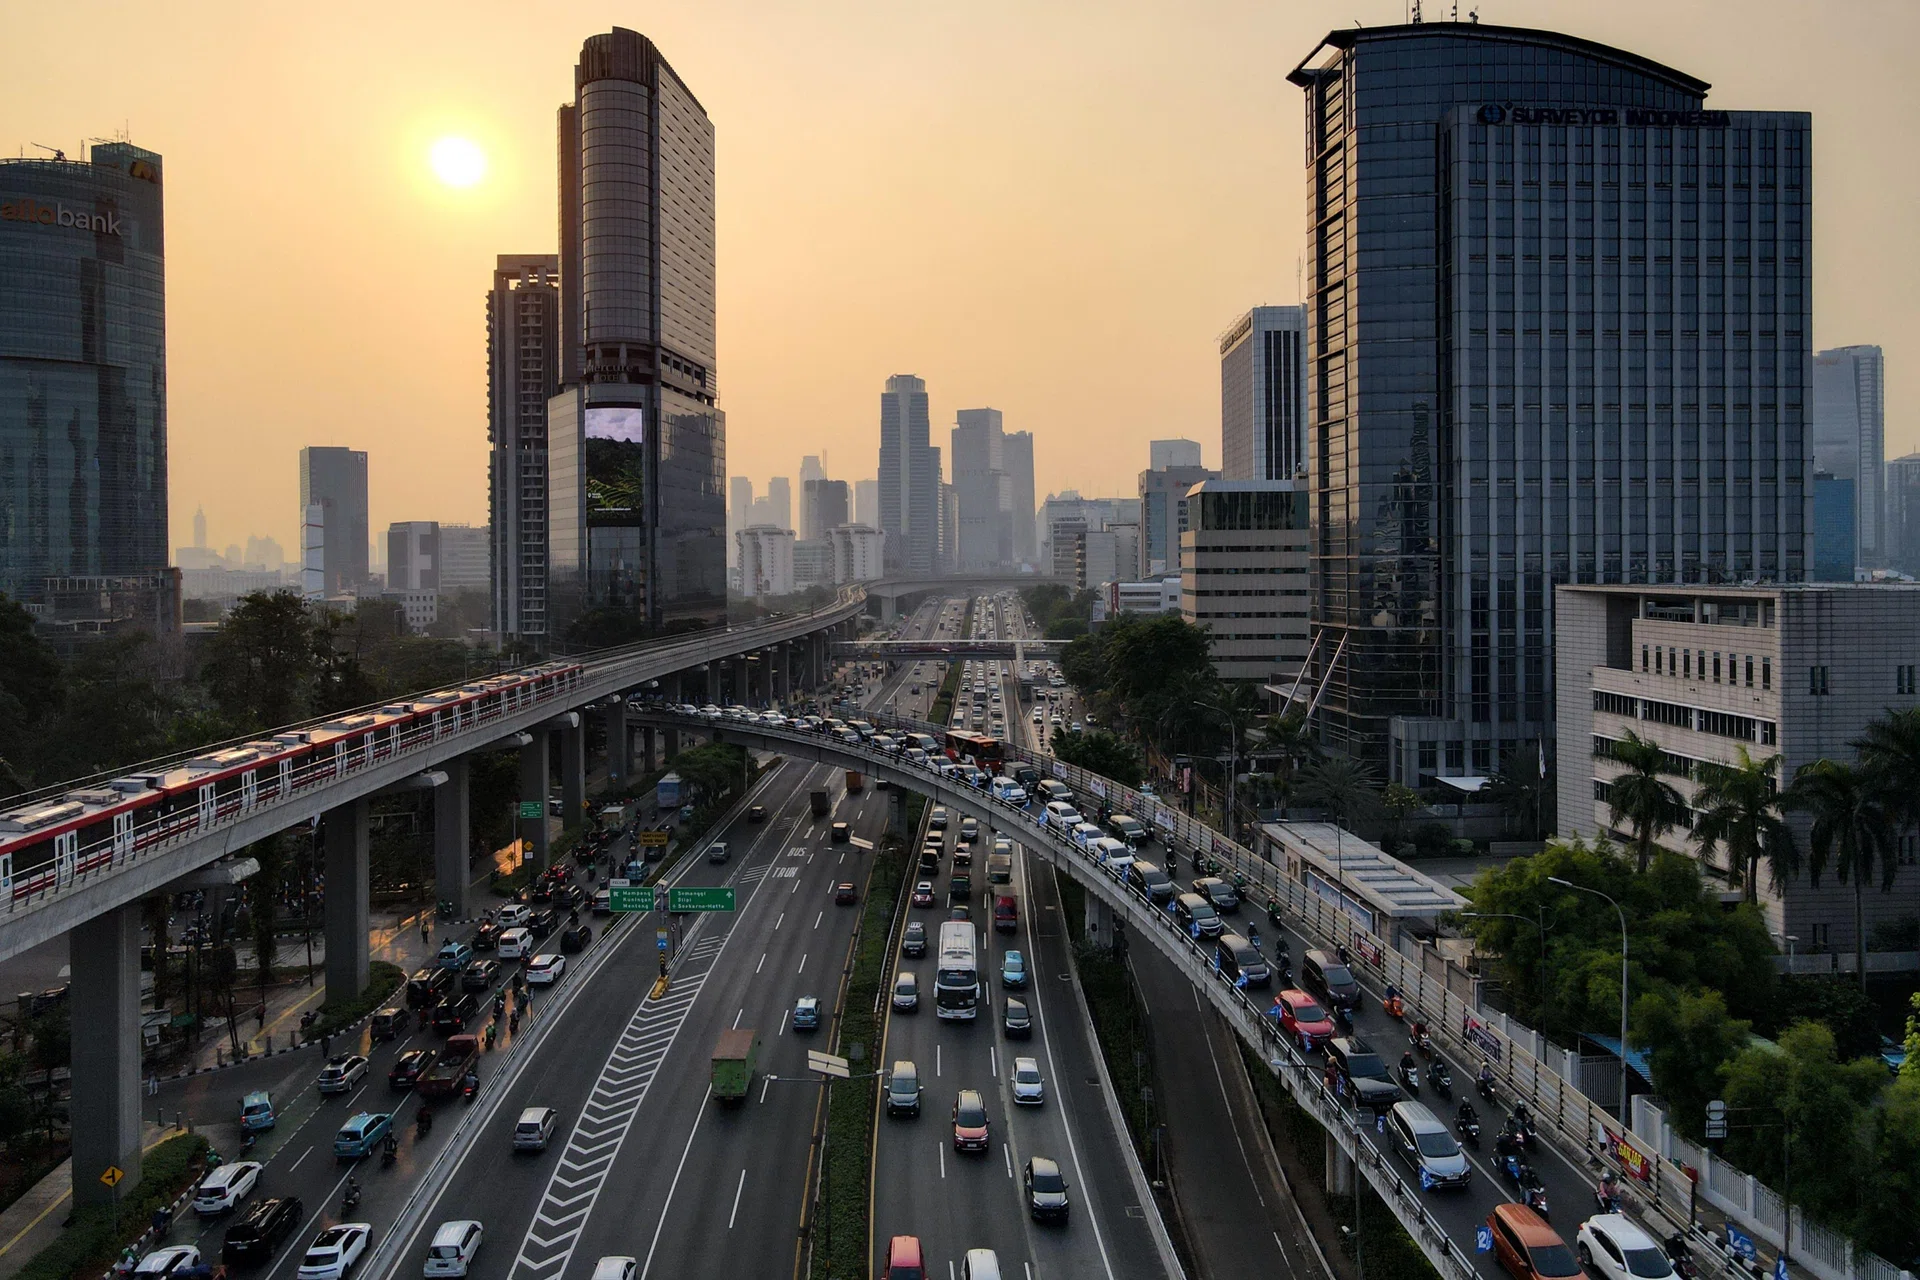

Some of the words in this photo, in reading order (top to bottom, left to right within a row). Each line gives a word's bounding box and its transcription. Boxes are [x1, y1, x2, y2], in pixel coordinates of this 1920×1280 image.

[1511, 107, 1618, 125] SURVEYOR
[1625, 109, 1731, 127] INDONESIA
[587, 363, 633, 373] Mercure
[787, 847, 807, 857] BUS
[1618, 1142, 1643, 1167] GANJAR
